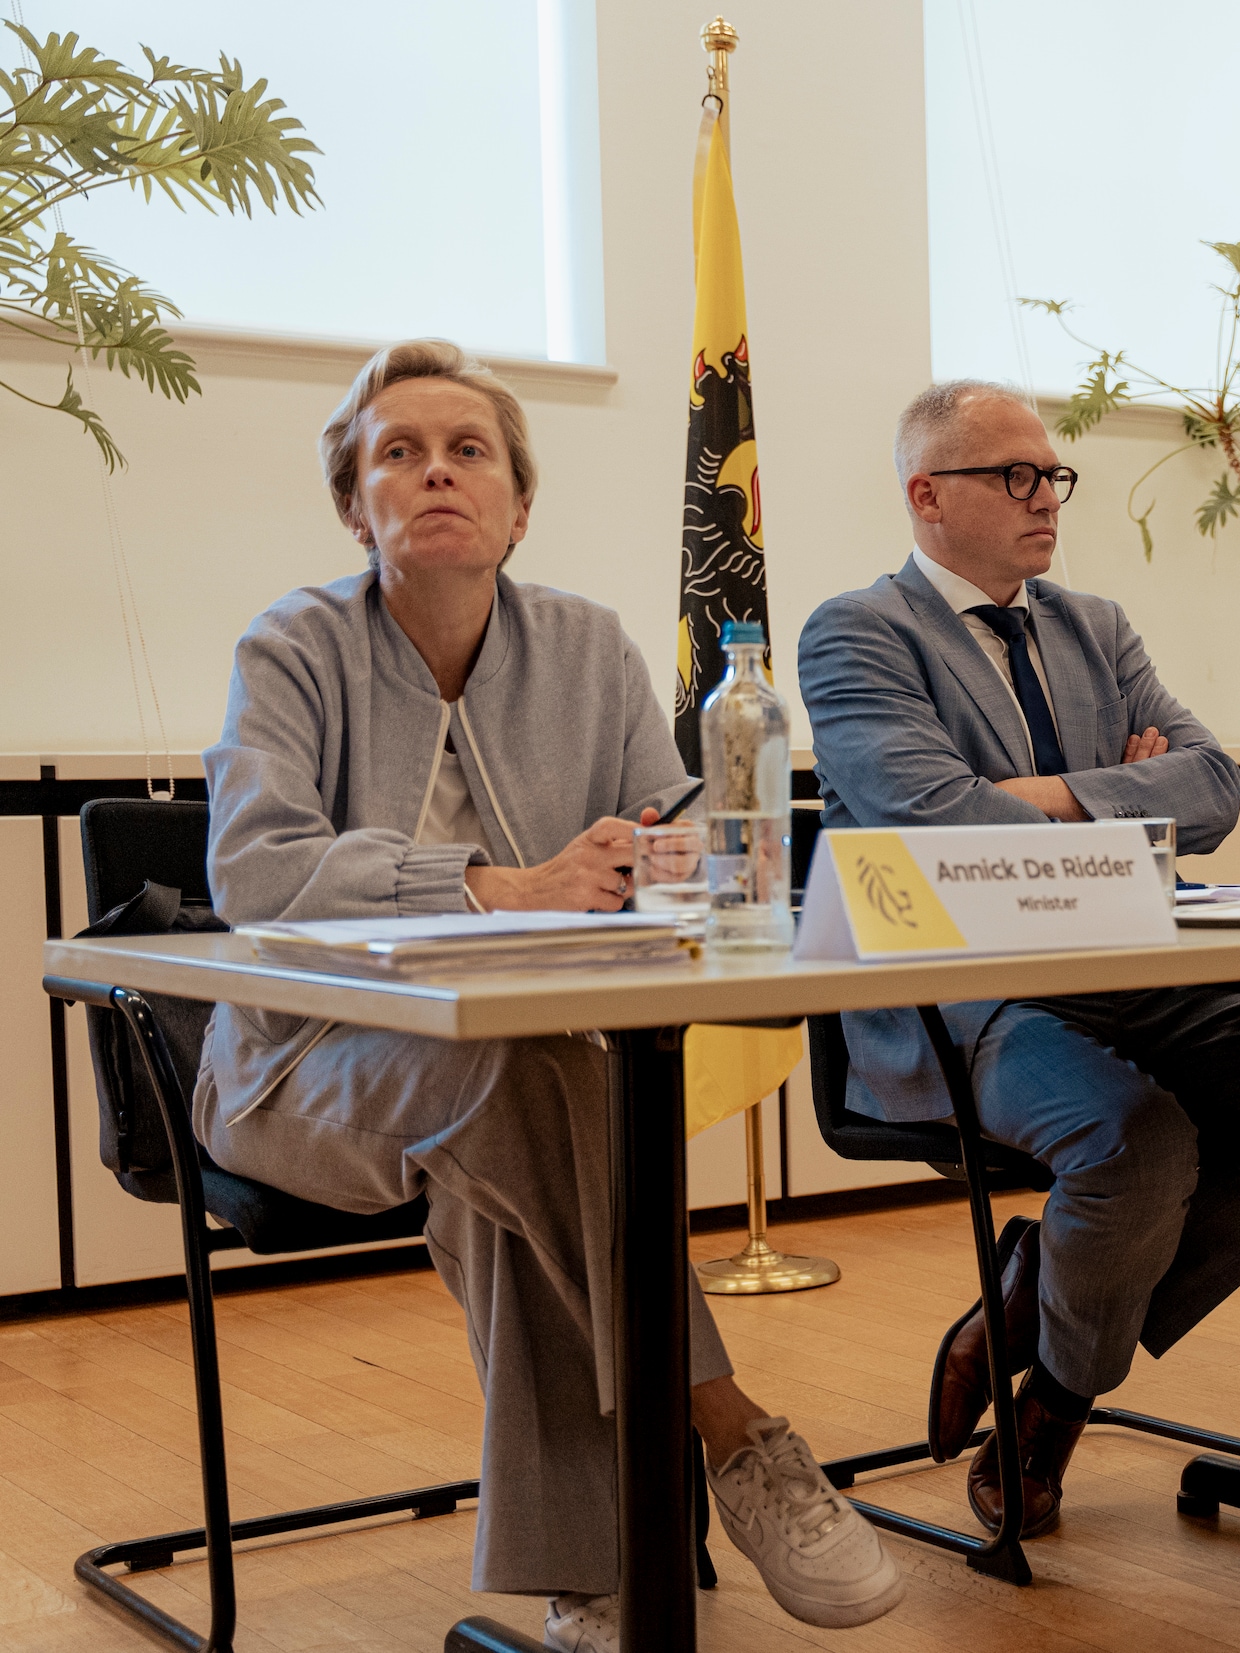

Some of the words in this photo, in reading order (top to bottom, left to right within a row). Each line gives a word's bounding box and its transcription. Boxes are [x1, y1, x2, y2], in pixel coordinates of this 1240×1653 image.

[937, 857, 1018, 882] Annick
[1022, 858, 1056, 880] De
[1061, 855, 1134, 879] Ridder
[1017, 896, 1078, 912] Minister
